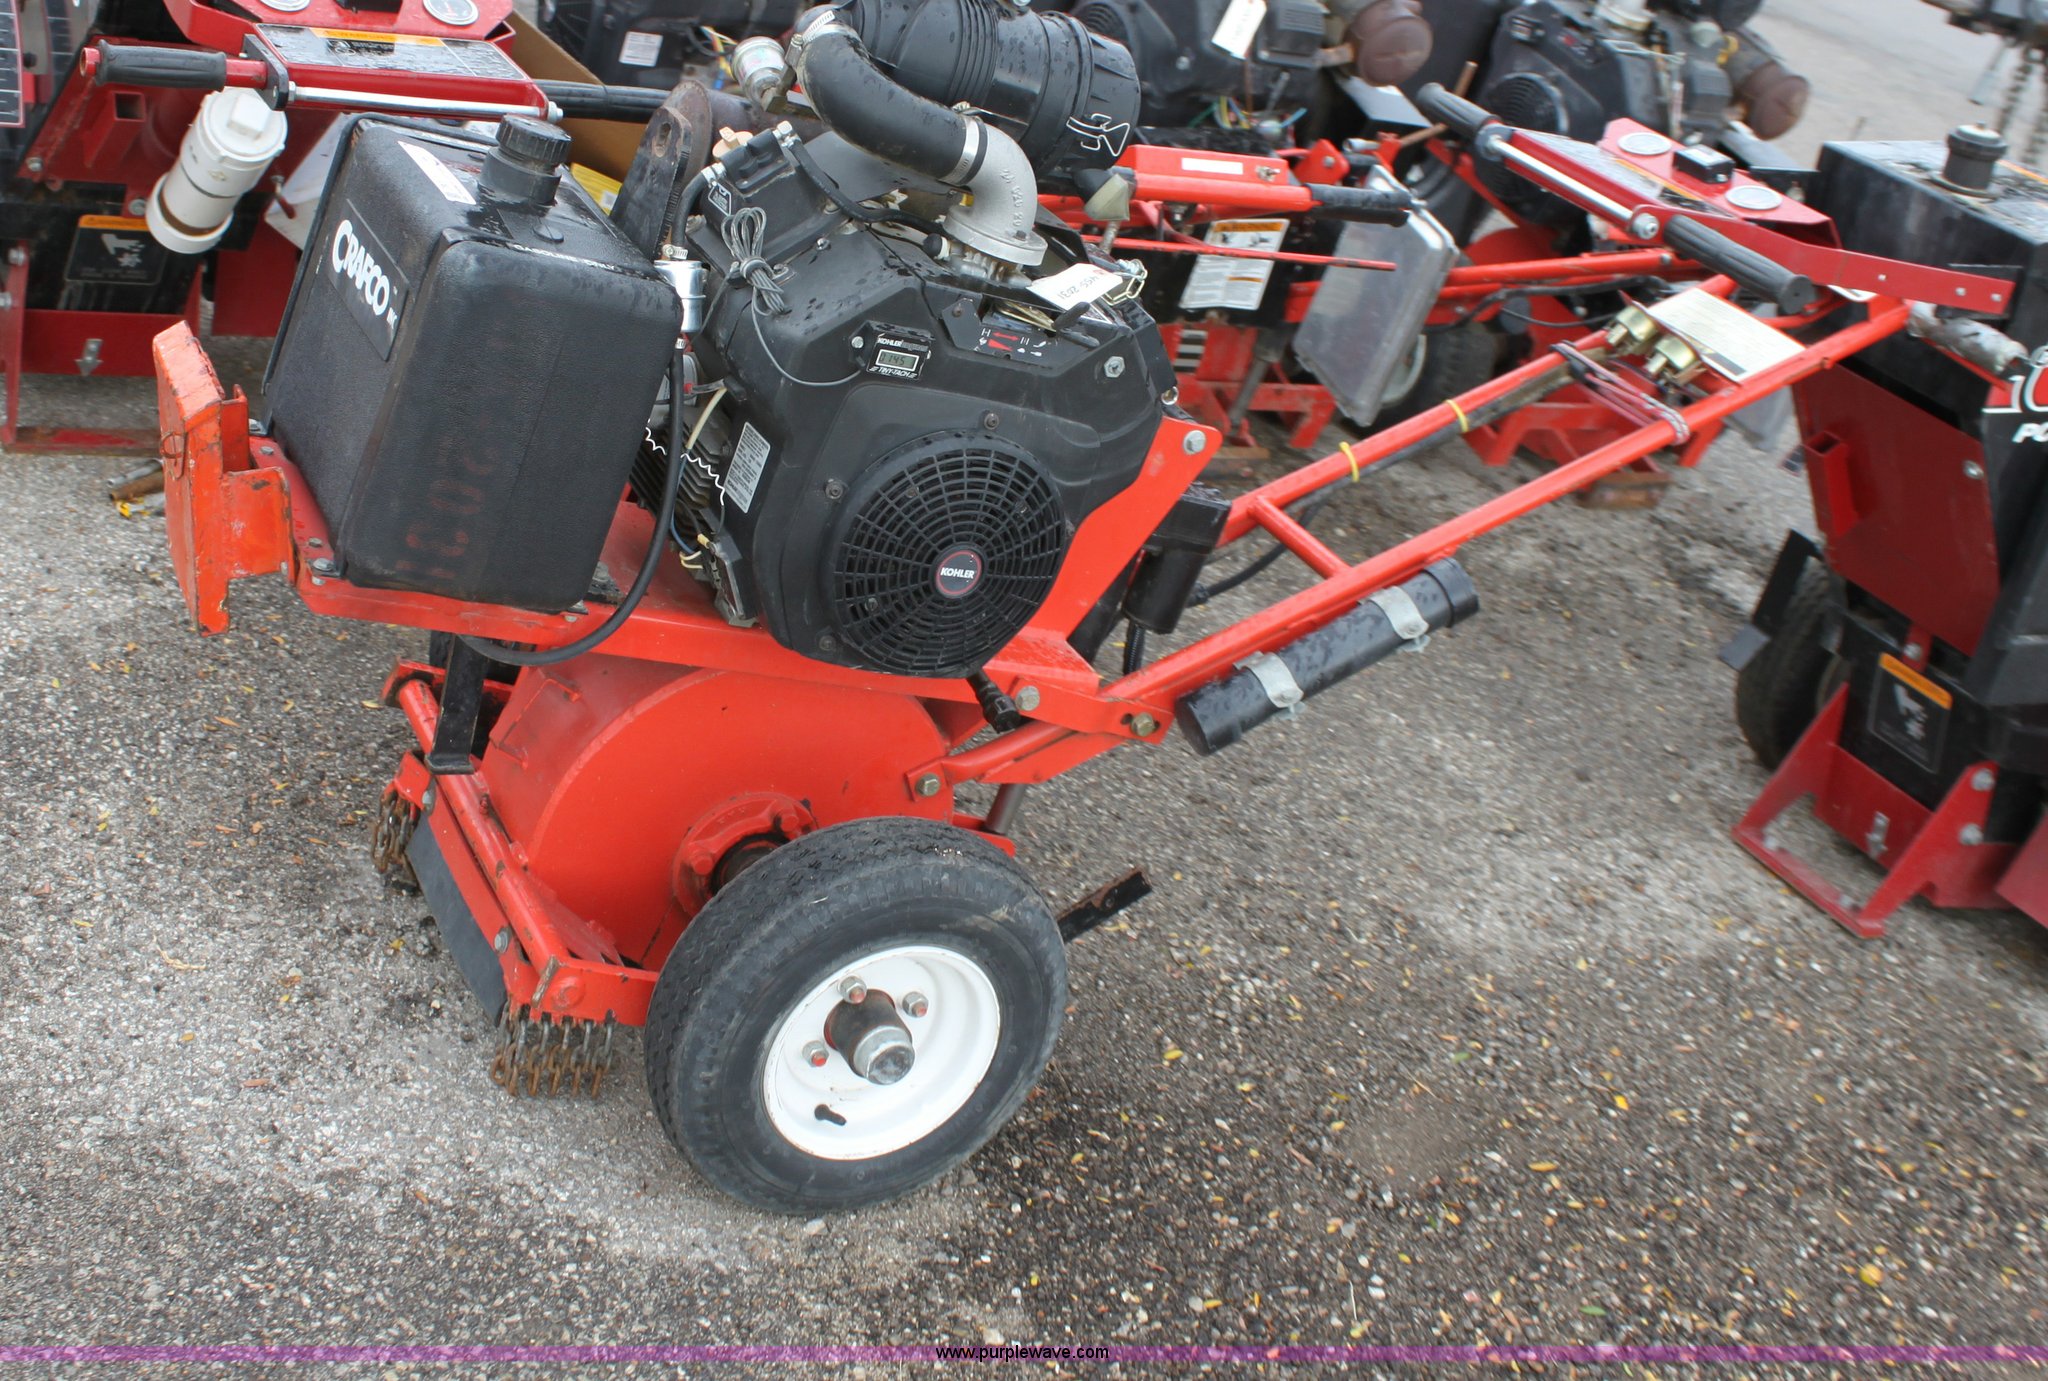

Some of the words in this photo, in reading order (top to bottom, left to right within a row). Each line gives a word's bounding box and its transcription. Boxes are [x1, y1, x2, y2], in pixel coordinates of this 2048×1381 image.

[332, 219, 390, 315] CRAFCO
[877, 337, 903, 347] KOHLER
[940, 566, 975, 579] KOHLER
